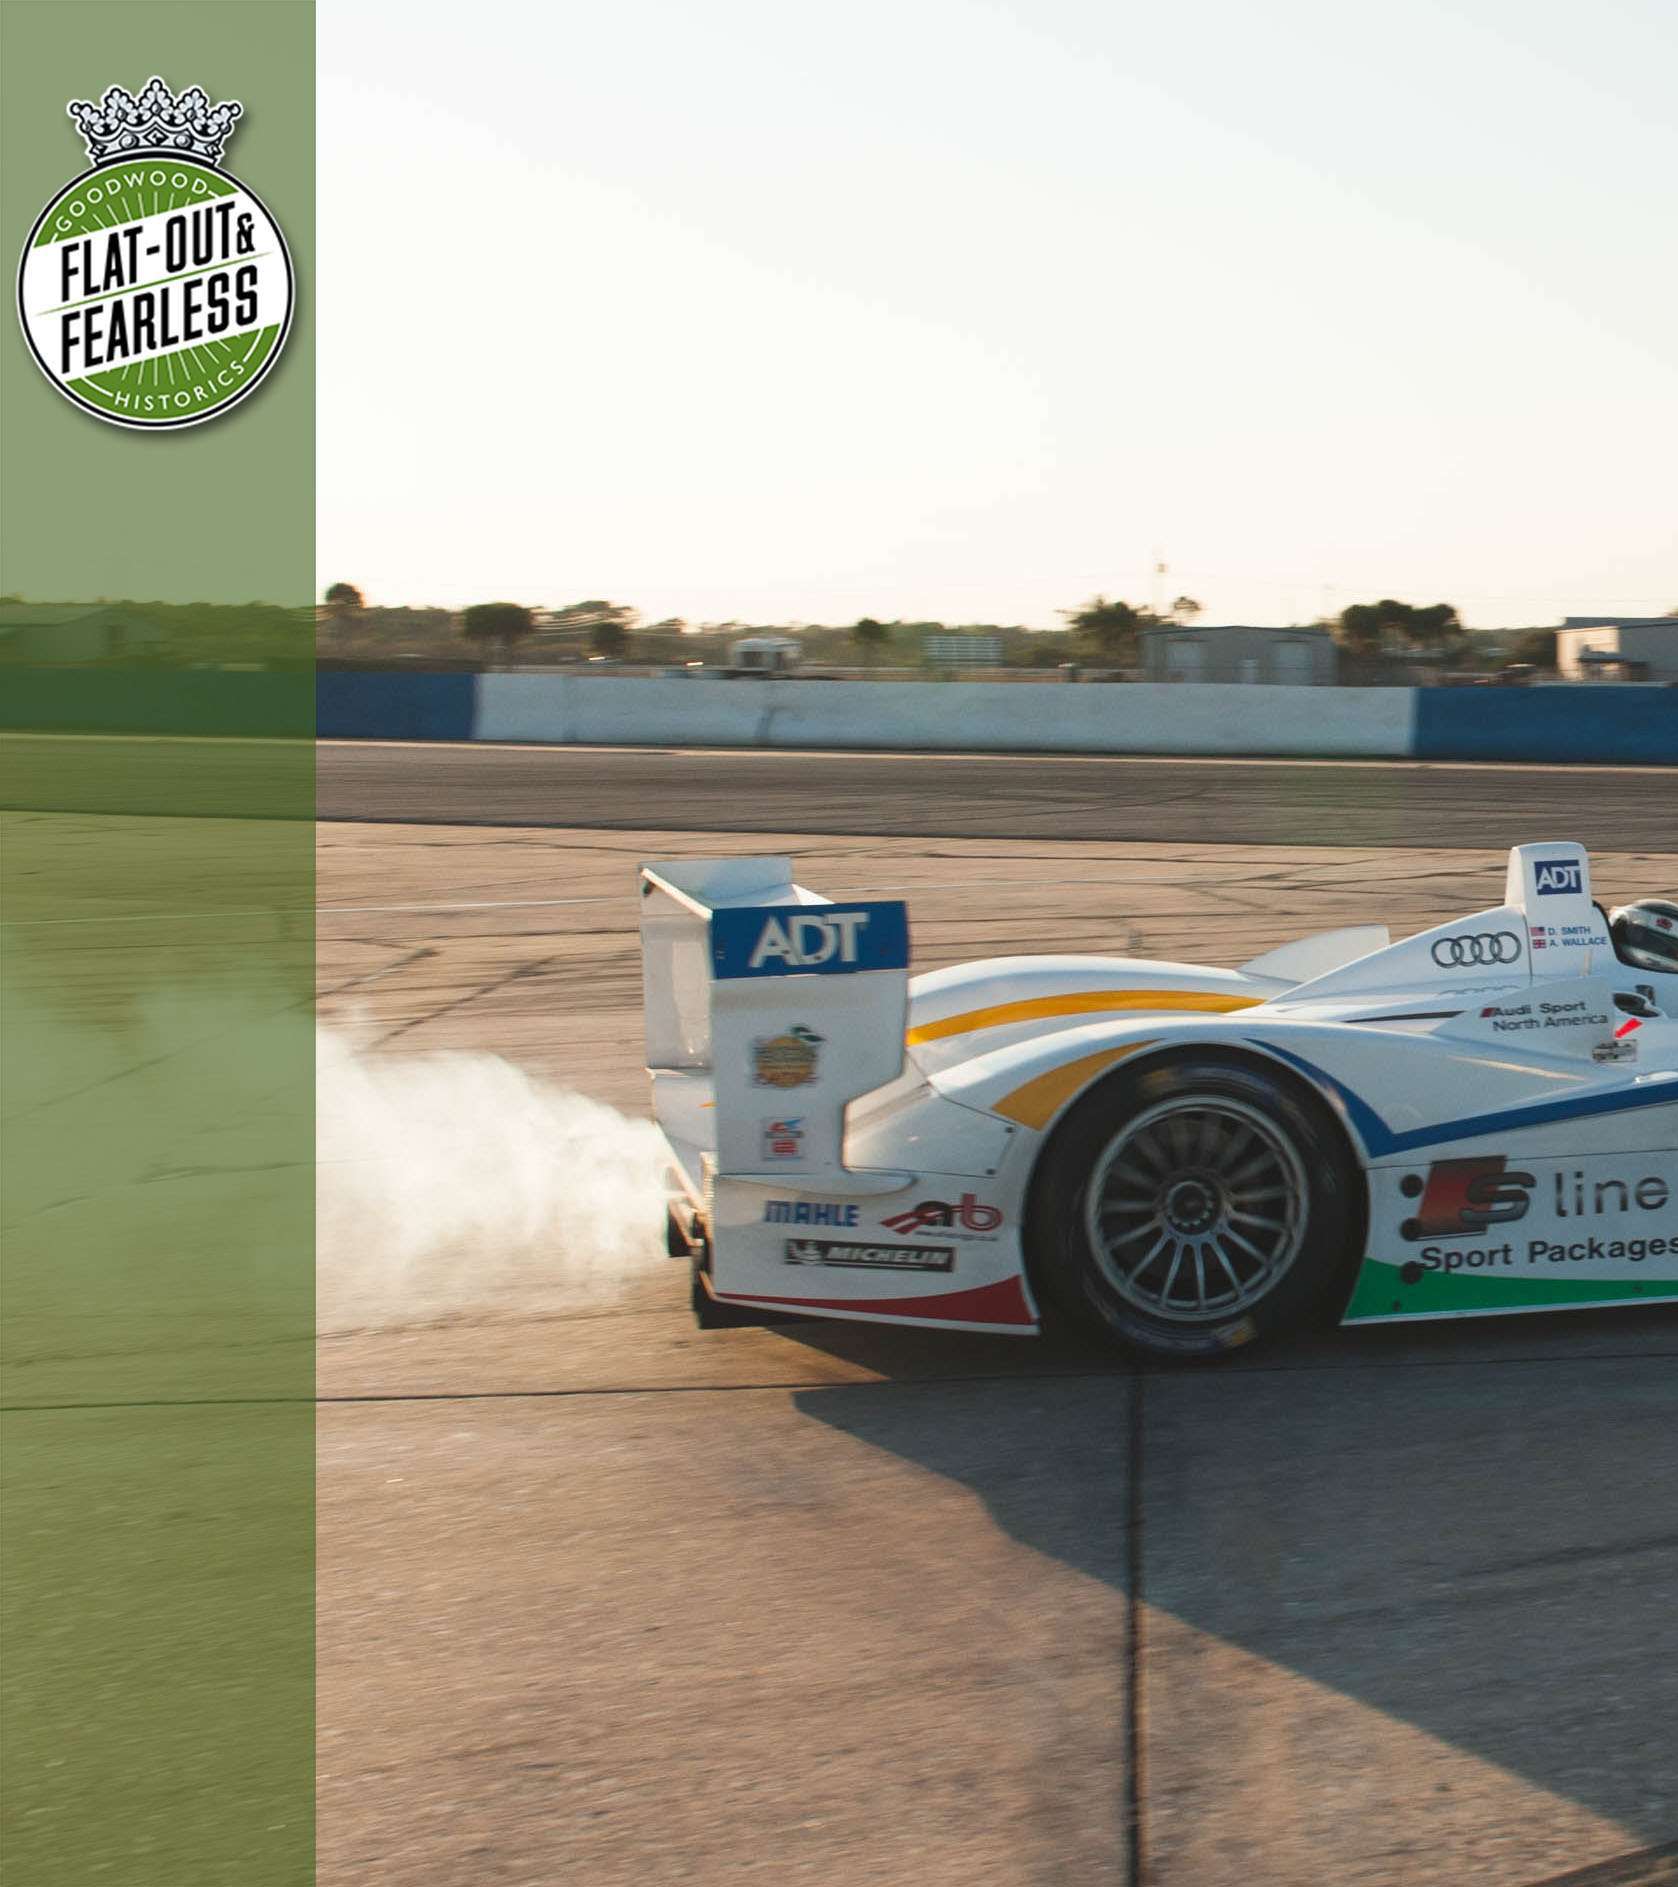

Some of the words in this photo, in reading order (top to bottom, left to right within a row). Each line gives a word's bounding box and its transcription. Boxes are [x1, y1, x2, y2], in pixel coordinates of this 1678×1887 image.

[1537, 865, 1580, 891] ADT
[750, 912, 869, 968] ADT
[1561, 926, 1591, 936] SMITH
[1562, 936, 1608, 947] WALLACE
[1493, 1003, 1532, 1017] Audi
[1540, 1001, 1586, 1016] Sport
[1492, 1018, 1541, 1032] North
[1544, 1013, 1609, 1029] America
[1555, 1170, 1671, 1218] line
[764, 1200, 860, 1227] MAHLE
[826, 1246, 950, 1265] MICHELIN
[1418, 1242, 1513, 1274] Sport
